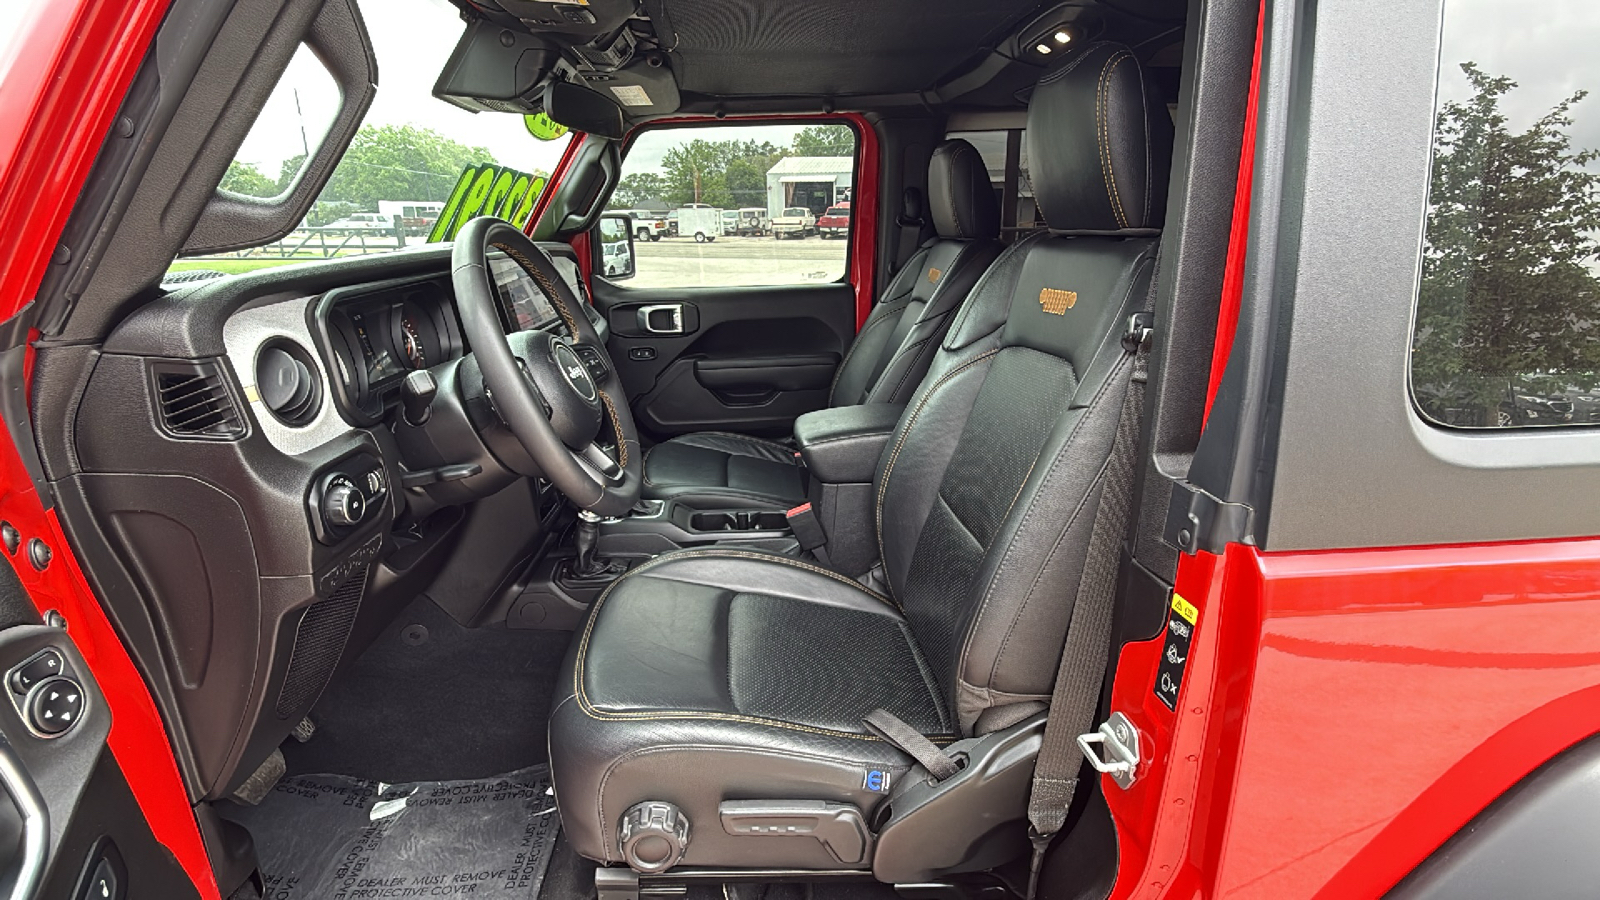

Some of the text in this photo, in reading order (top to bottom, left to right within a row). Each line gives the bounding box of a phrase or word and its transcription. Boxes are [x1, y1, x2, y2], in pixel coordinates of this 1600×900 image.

[276, 784, 319, 799] COVER
[431, 786, 470, 798] COVER
[458, 794, 487, 804] MUST
[492, 789, 534, 802] DEALER
[334, 845, 364, 879] COVER
[503, 852, 527, 890] DEALER
[520, 822, 537, 847] MUST
[518, 830, 546, 888] PROTECTIVE
[357, 869, 507, 888] DEALER MUST REMOVE
[350, 883, 478, 899] PROTECTIVE COVER
